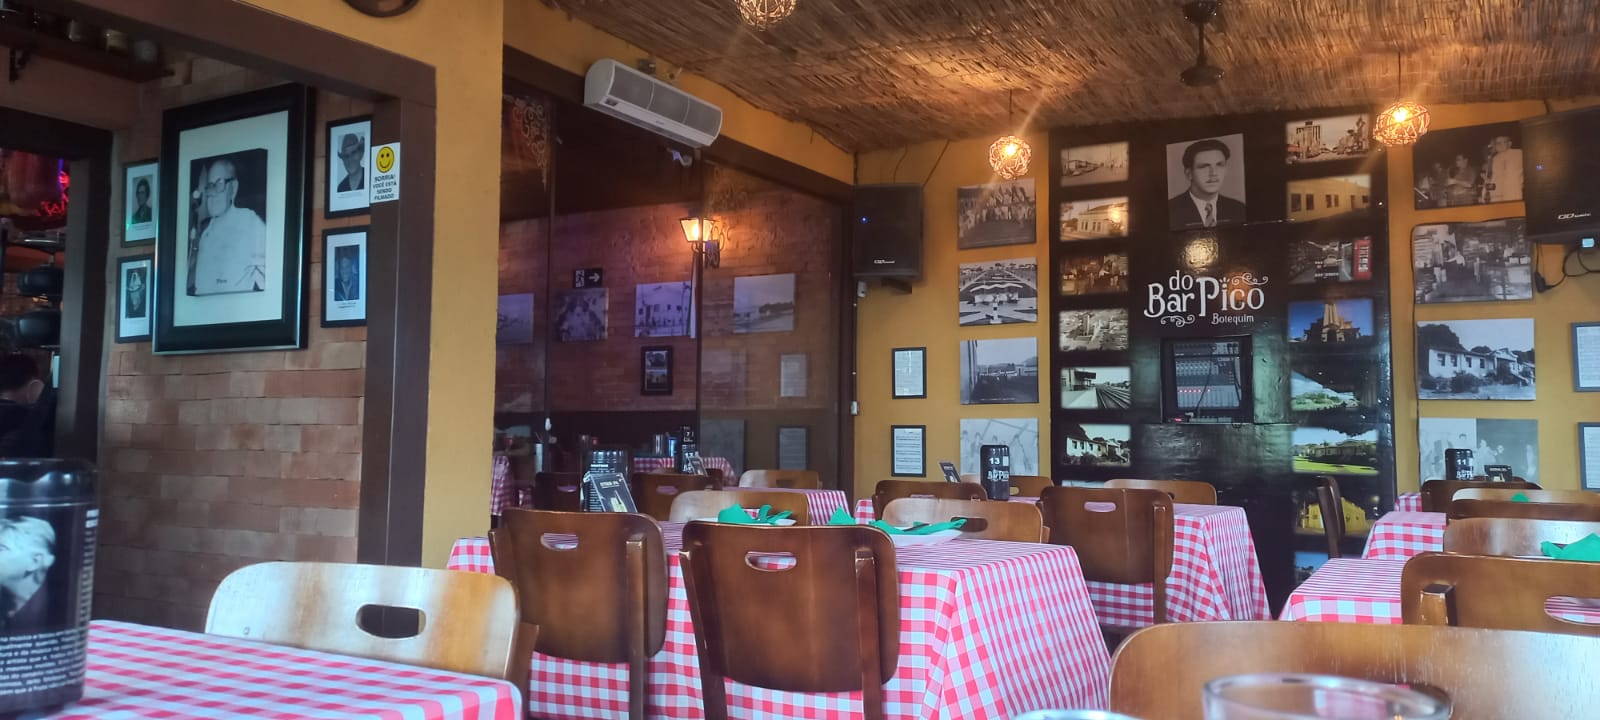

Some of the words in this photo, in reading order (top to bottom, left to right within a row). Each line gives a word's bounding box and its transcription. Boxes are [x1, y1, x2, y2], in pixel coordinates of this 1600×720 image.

[1169, 270, 1193, 291] do
[1144, 283, 1195, 318] Bar
[1196, 277, 1265, 317] Pico
[1211, 312, 1254, 325] Botequim
[989, 457, 1000, 465] 13
